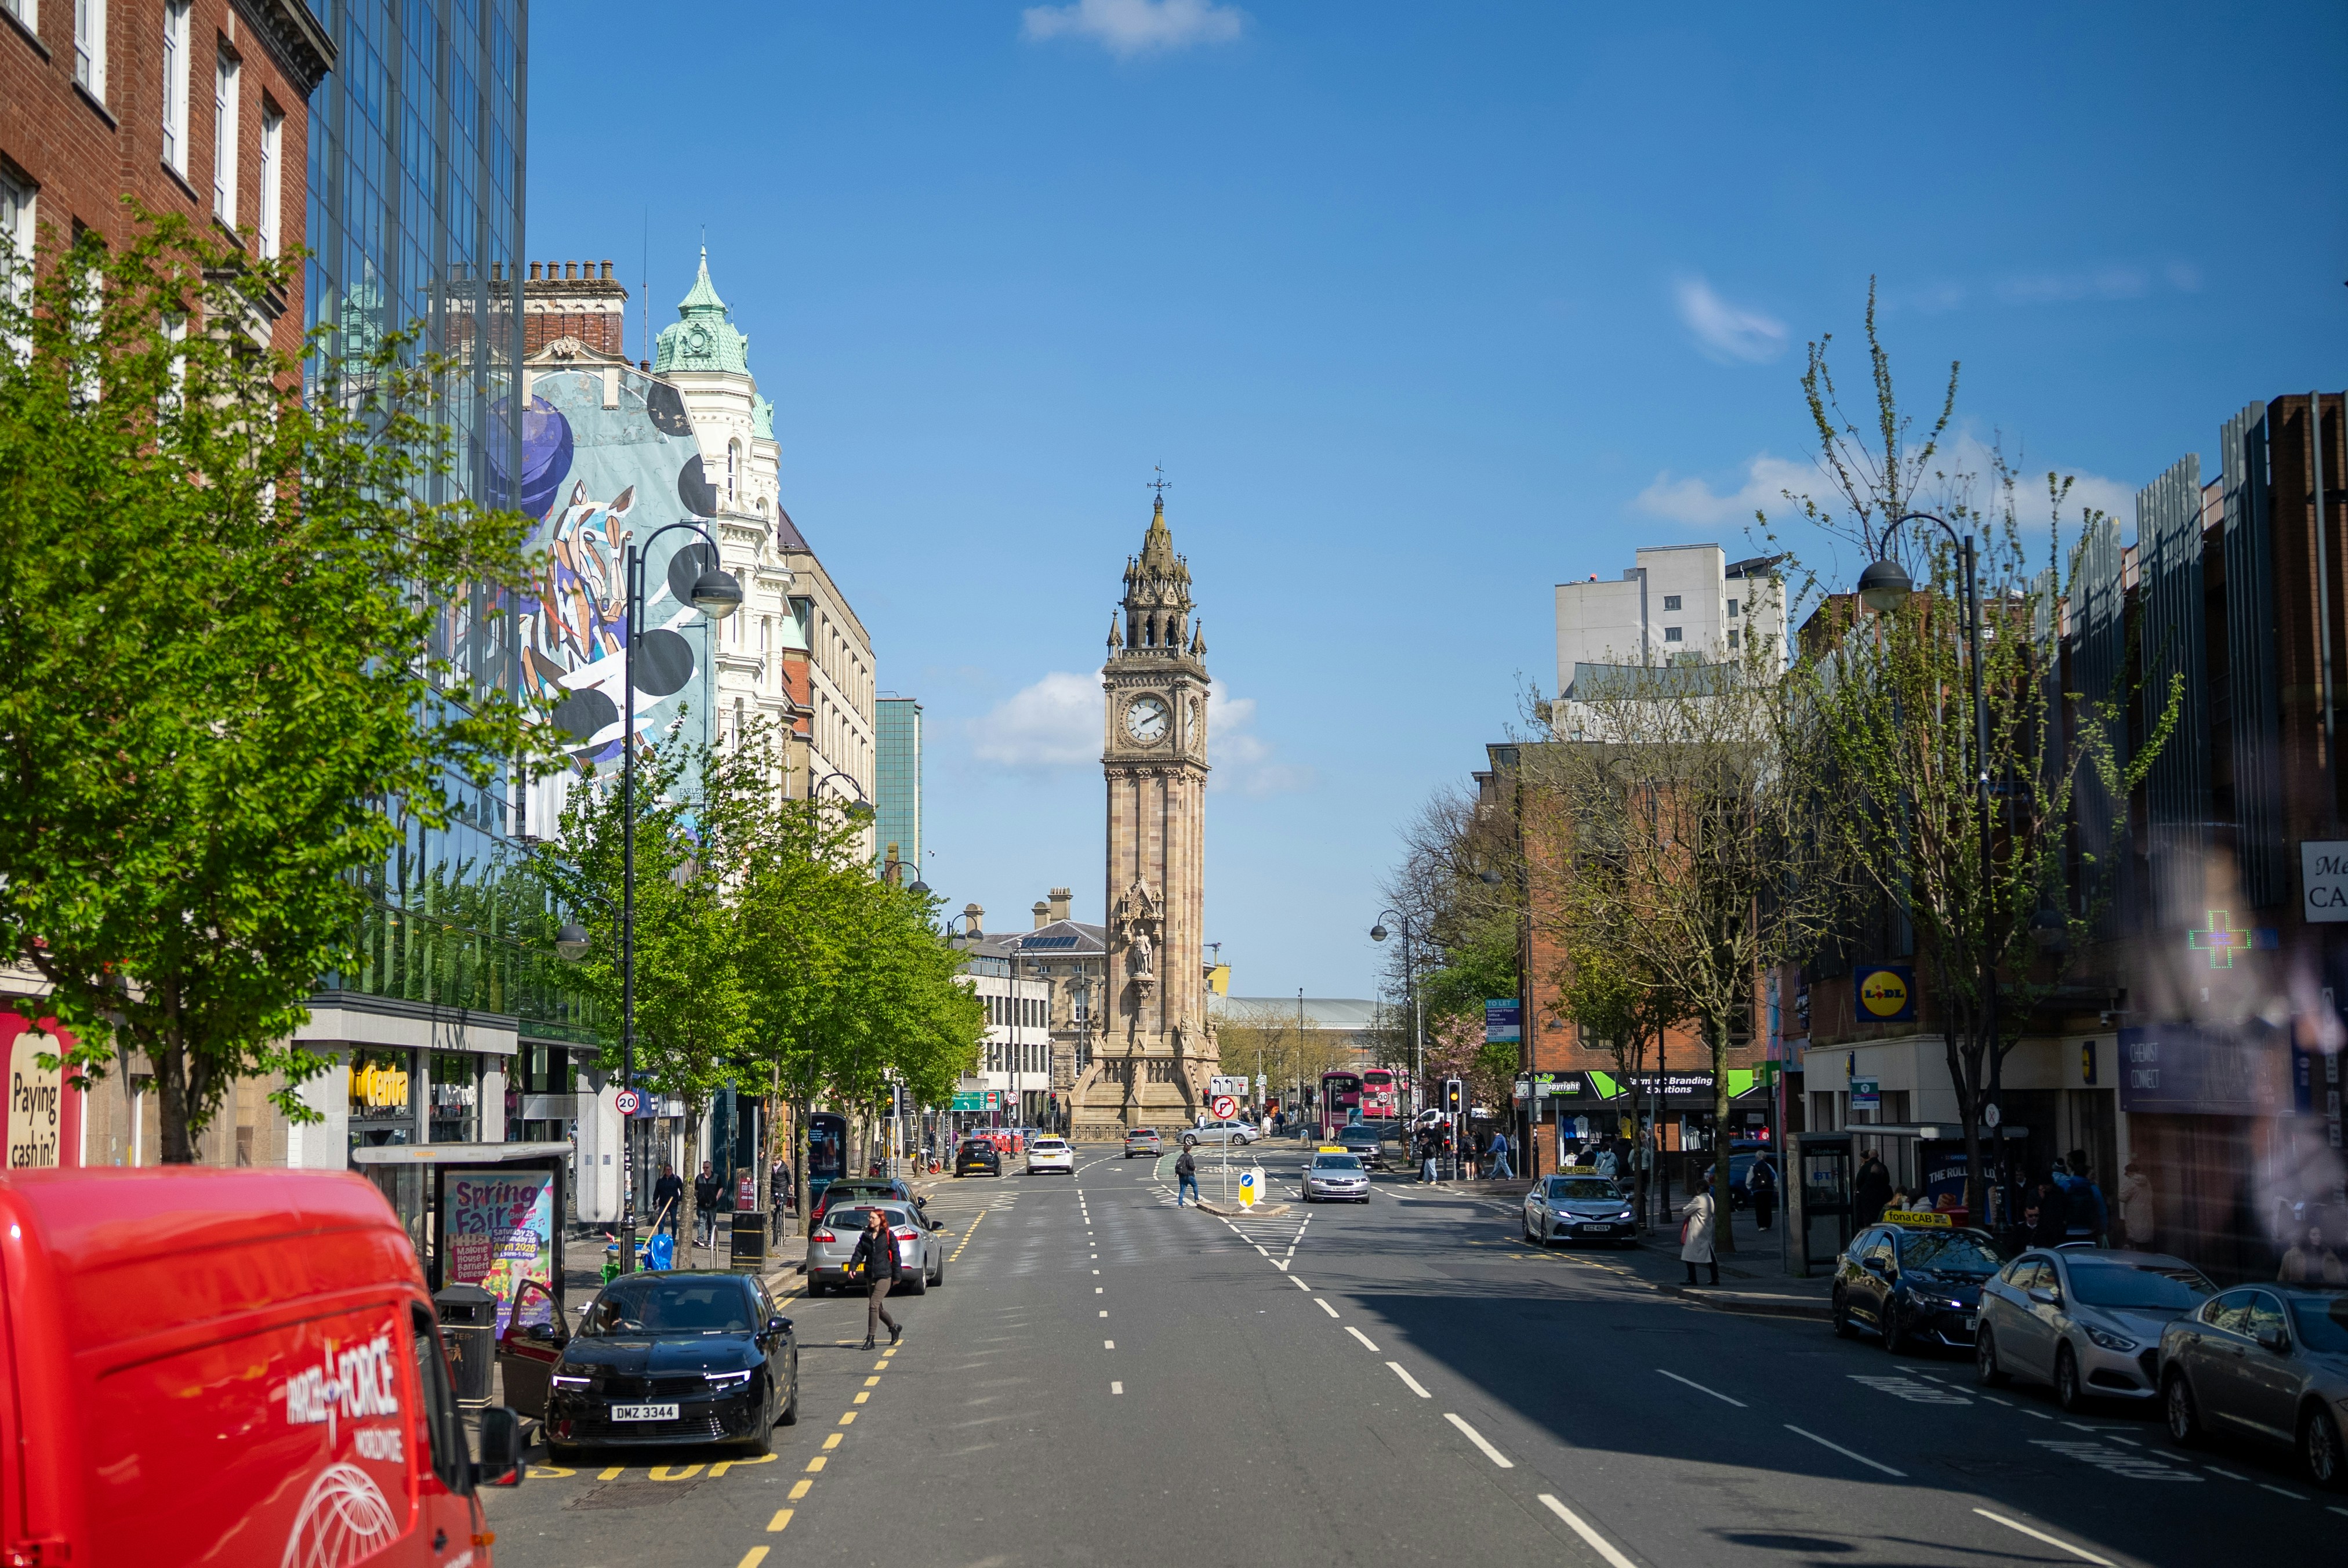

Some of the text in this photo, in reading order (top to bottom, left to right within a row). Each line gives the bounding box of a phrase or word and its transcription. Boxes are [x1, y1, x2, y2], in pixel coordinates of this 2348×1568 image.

[2129, 1042, 2159, 1062] CHEMIST
[367, 1059, 408, 1107] Centra
[1669, 1076, 1713, 1086] Branding
[2130, 1069, 2160, 1089] CONNECT
[1548, 1082, 1579, 1091] opyright
[14, 1072, 57, 1126] Paying
[619, 1098, 635, 1107] 20
[12, 1130, 56, 1169] cash in?
[1813, 1172, 1831, 1181] BT
[1929, 1169, 1946, 1184] THE
[456, 1181, 538, 1211] Spring
[456, 1206, 508, 1239] Fair
[457, 1246, 488, 1255] Malone
[493, 1243, 536, 1253] April 2026
[458, 1253, 489, 1263] House &
[458, 1261, 489, 1271] Barnett
[458, 1269, 491, 1279] Demesne
[617, 1406, 674, 1419] DMZ 3344
